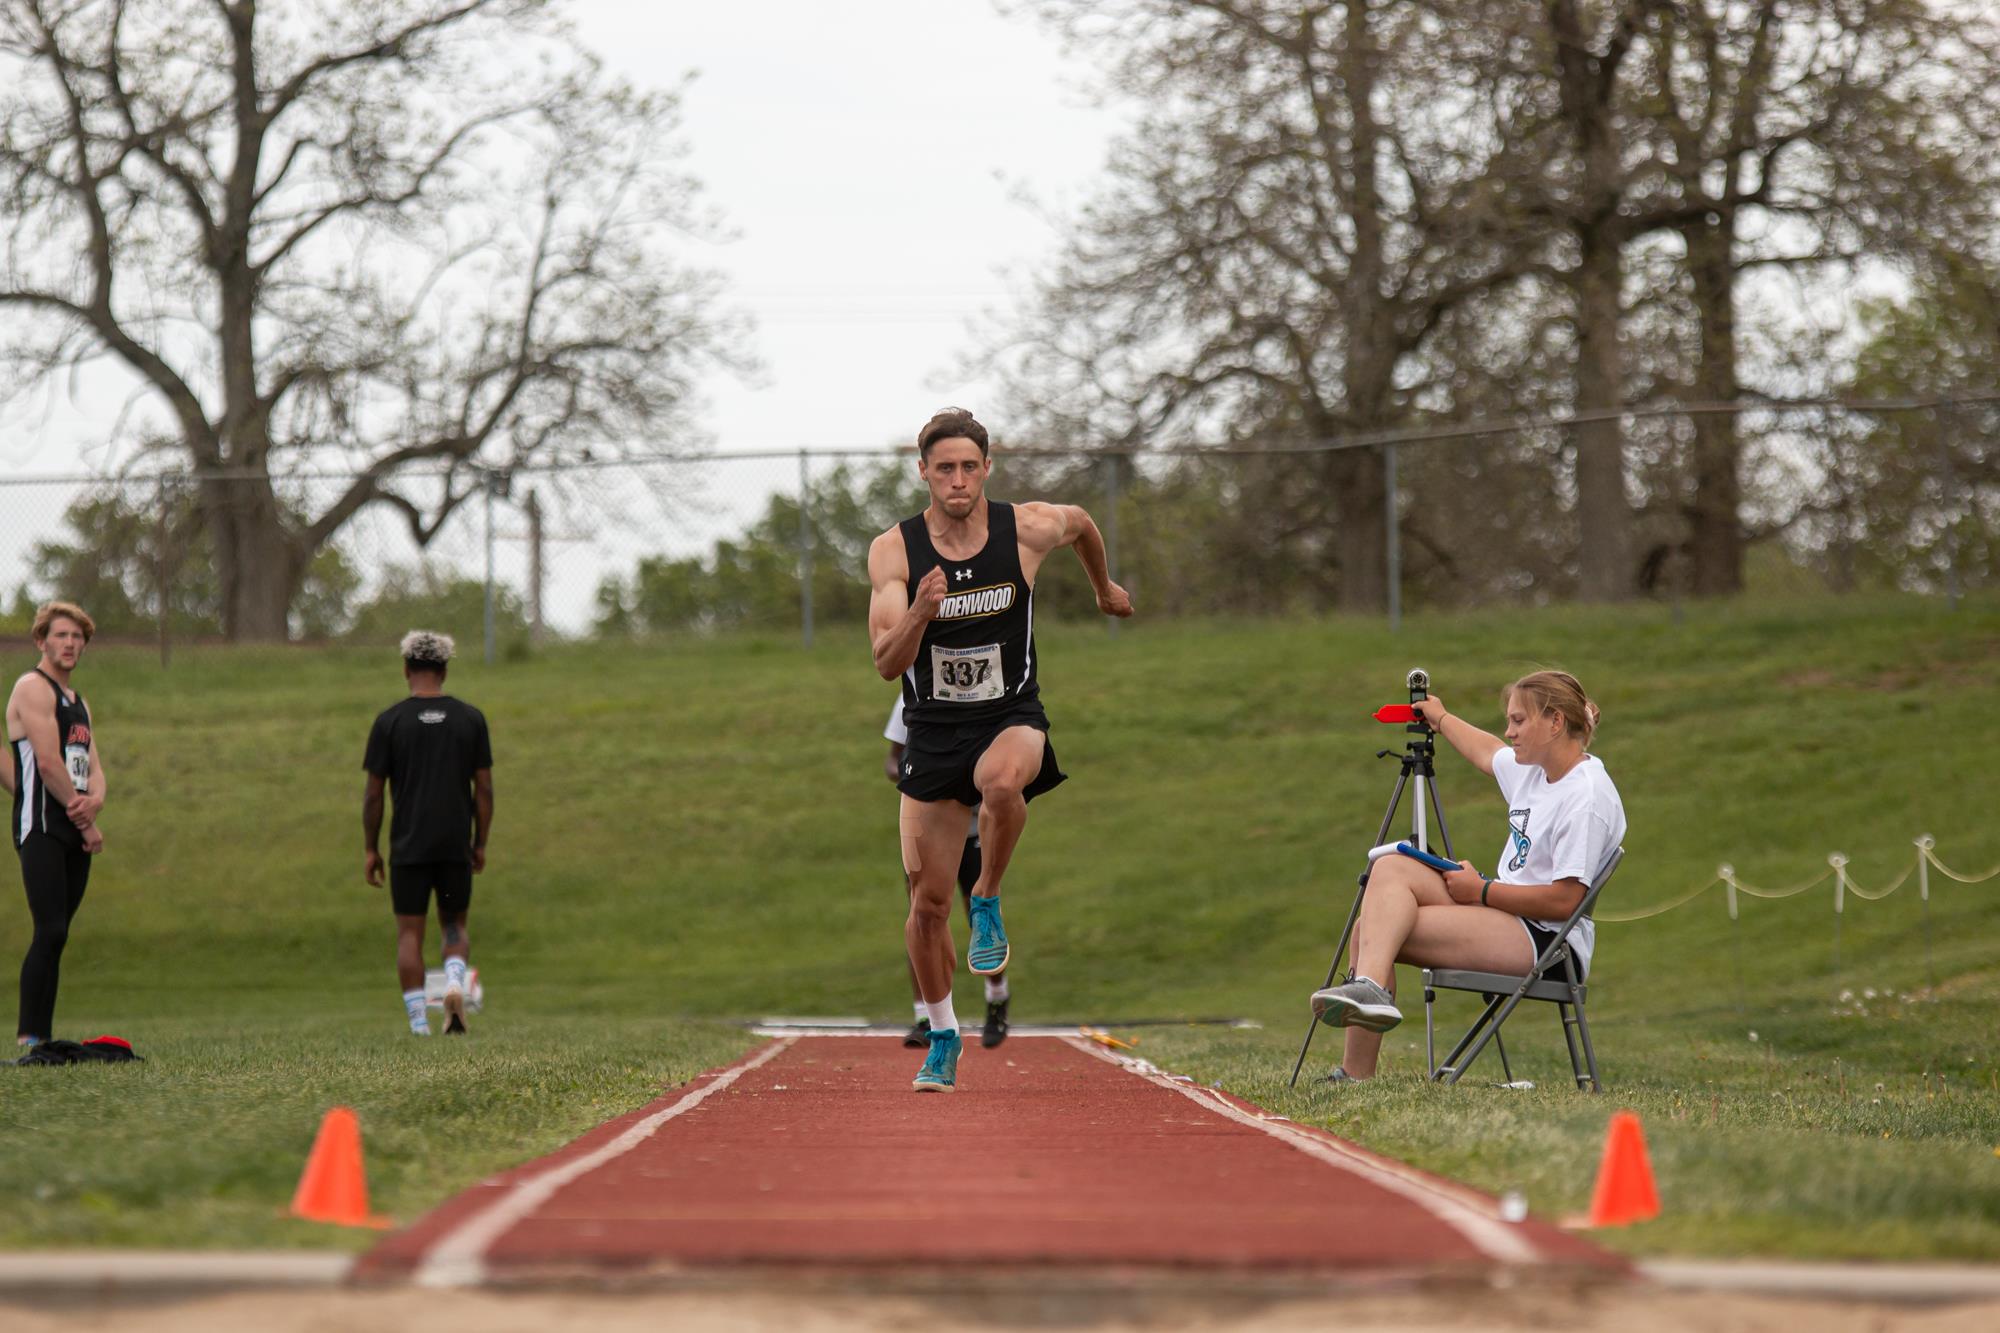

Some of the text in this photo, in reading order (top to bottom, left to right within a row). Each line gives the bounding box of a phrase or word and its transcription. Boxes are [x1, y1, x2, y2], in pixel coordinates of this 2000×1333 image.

[935, 586, 1013, 619] NDENWOOD
[956, 645, 995, 657] CHAMPIONSHIPS
[941, 658, 990, 687] 337
